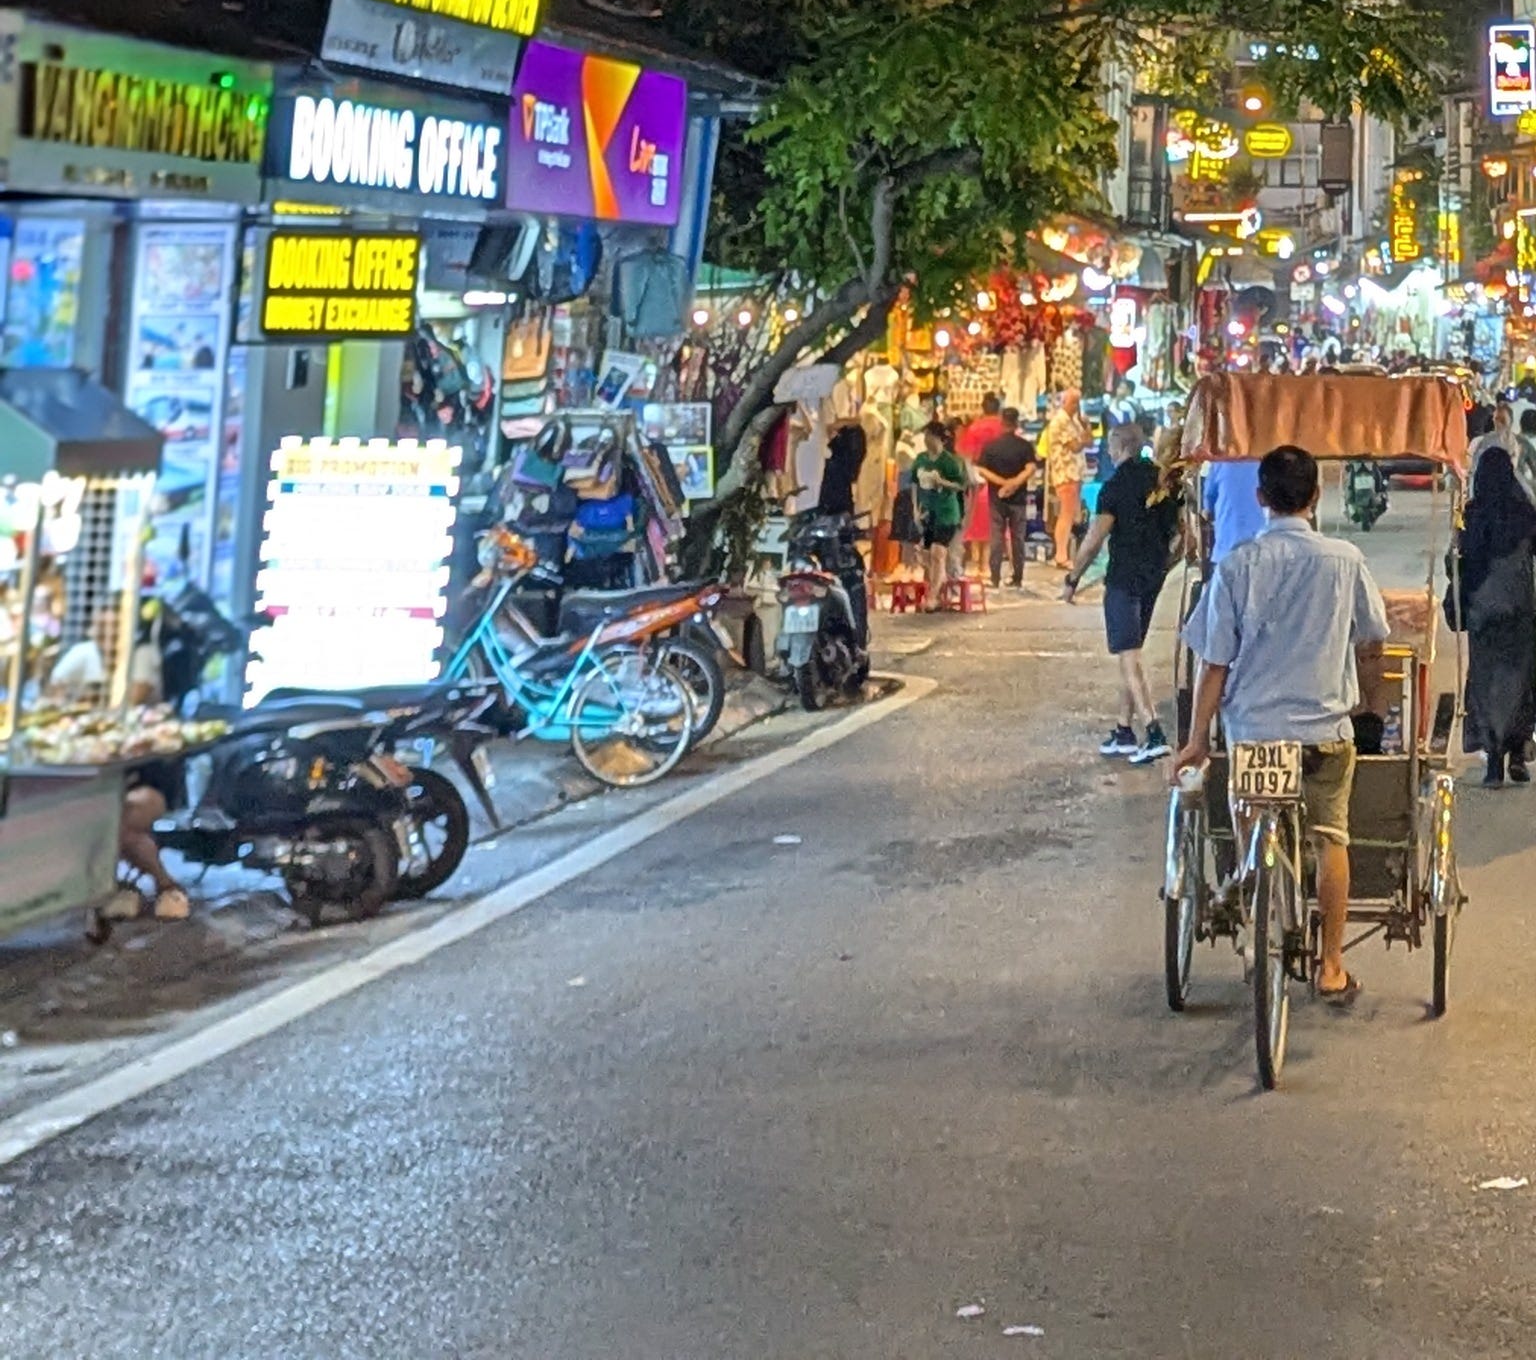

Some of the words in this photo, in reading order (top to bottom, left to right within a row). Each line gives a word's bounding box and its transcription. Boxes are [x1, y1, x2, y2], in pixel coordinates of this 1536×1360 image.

[289, 95, 416, 191] BOOKING
[418, 115, 501, 200] OFFICE
[268, 236, 352, 290] BOOKING
[352, 238, 418, 291] OFFICE
[1247, 745, 1287, 769] 29XL
[1240, 771, 1292, 794] 0097
